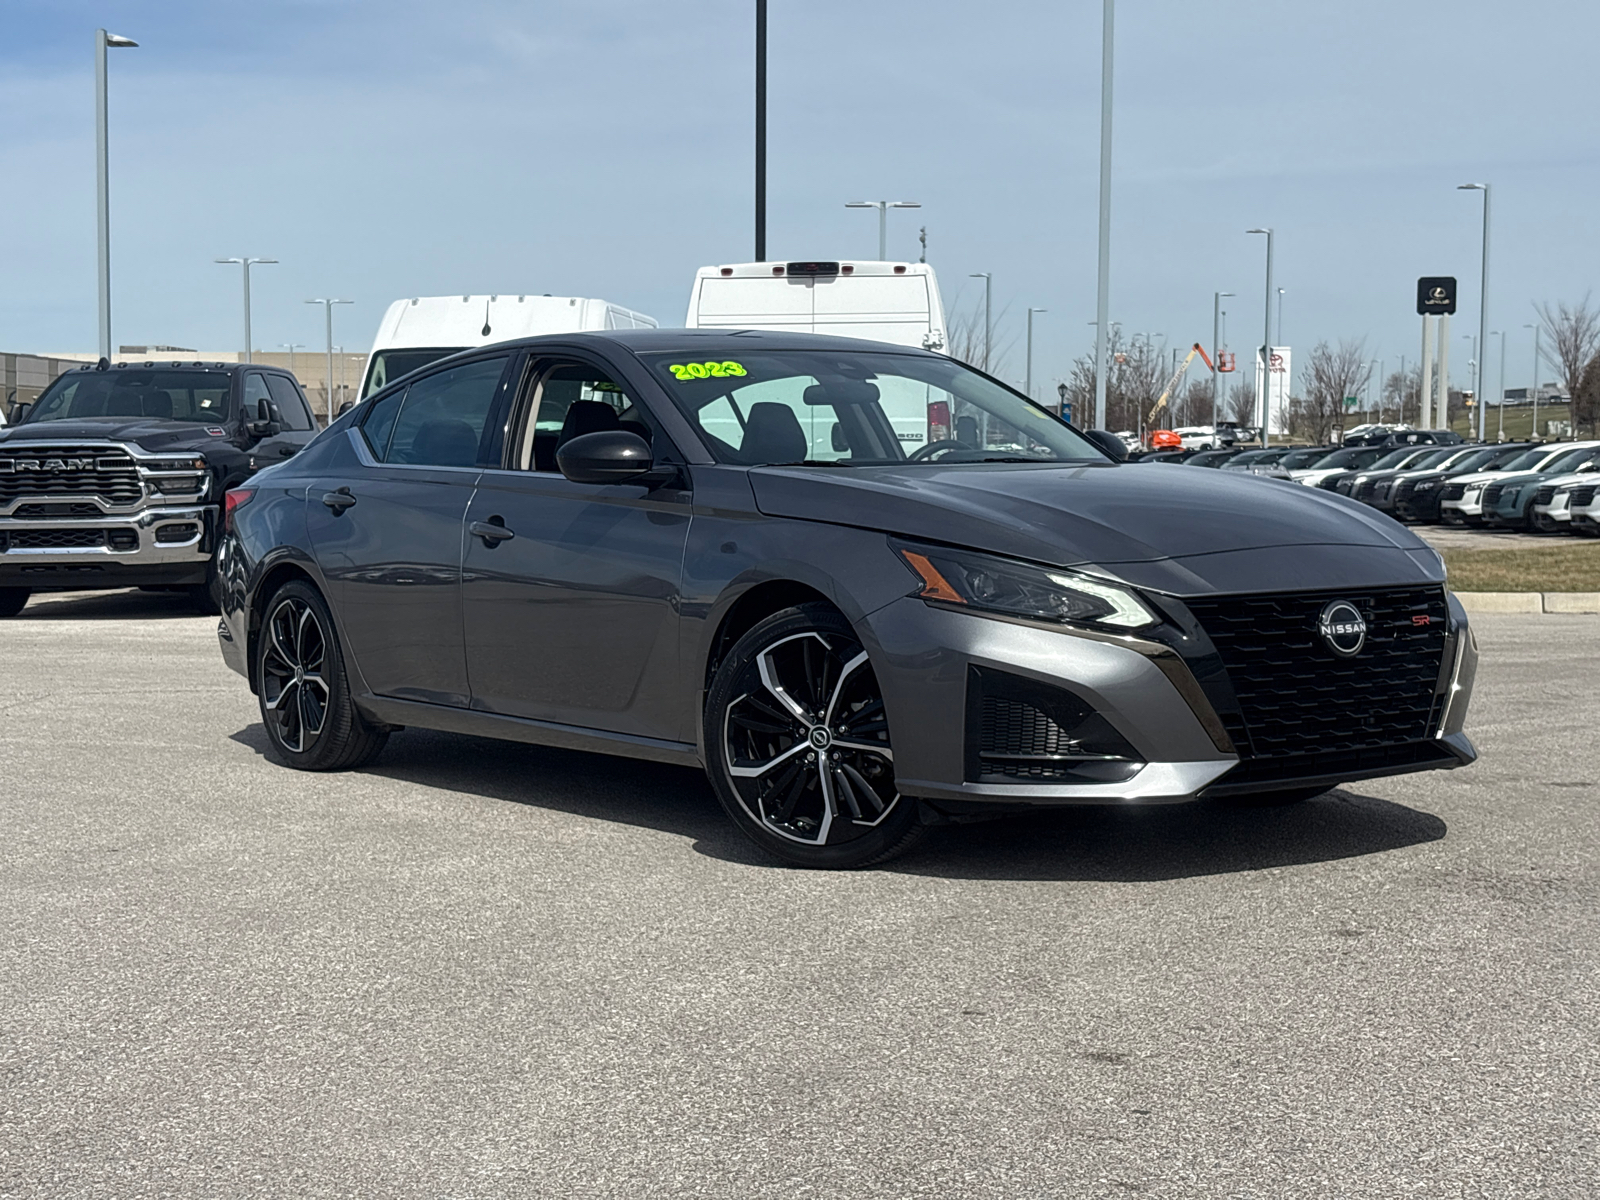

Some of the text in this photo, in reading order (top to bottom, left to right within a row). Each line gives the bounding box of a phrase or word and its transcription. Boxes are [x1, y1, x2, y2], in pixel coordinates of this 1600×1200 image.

[669, 361, 747, 380] 2023
[15, 458, 95, 471] RAM
[1412, 615, 1430, 626] SR
[1320, 624, 1366, 635] NISSAN
